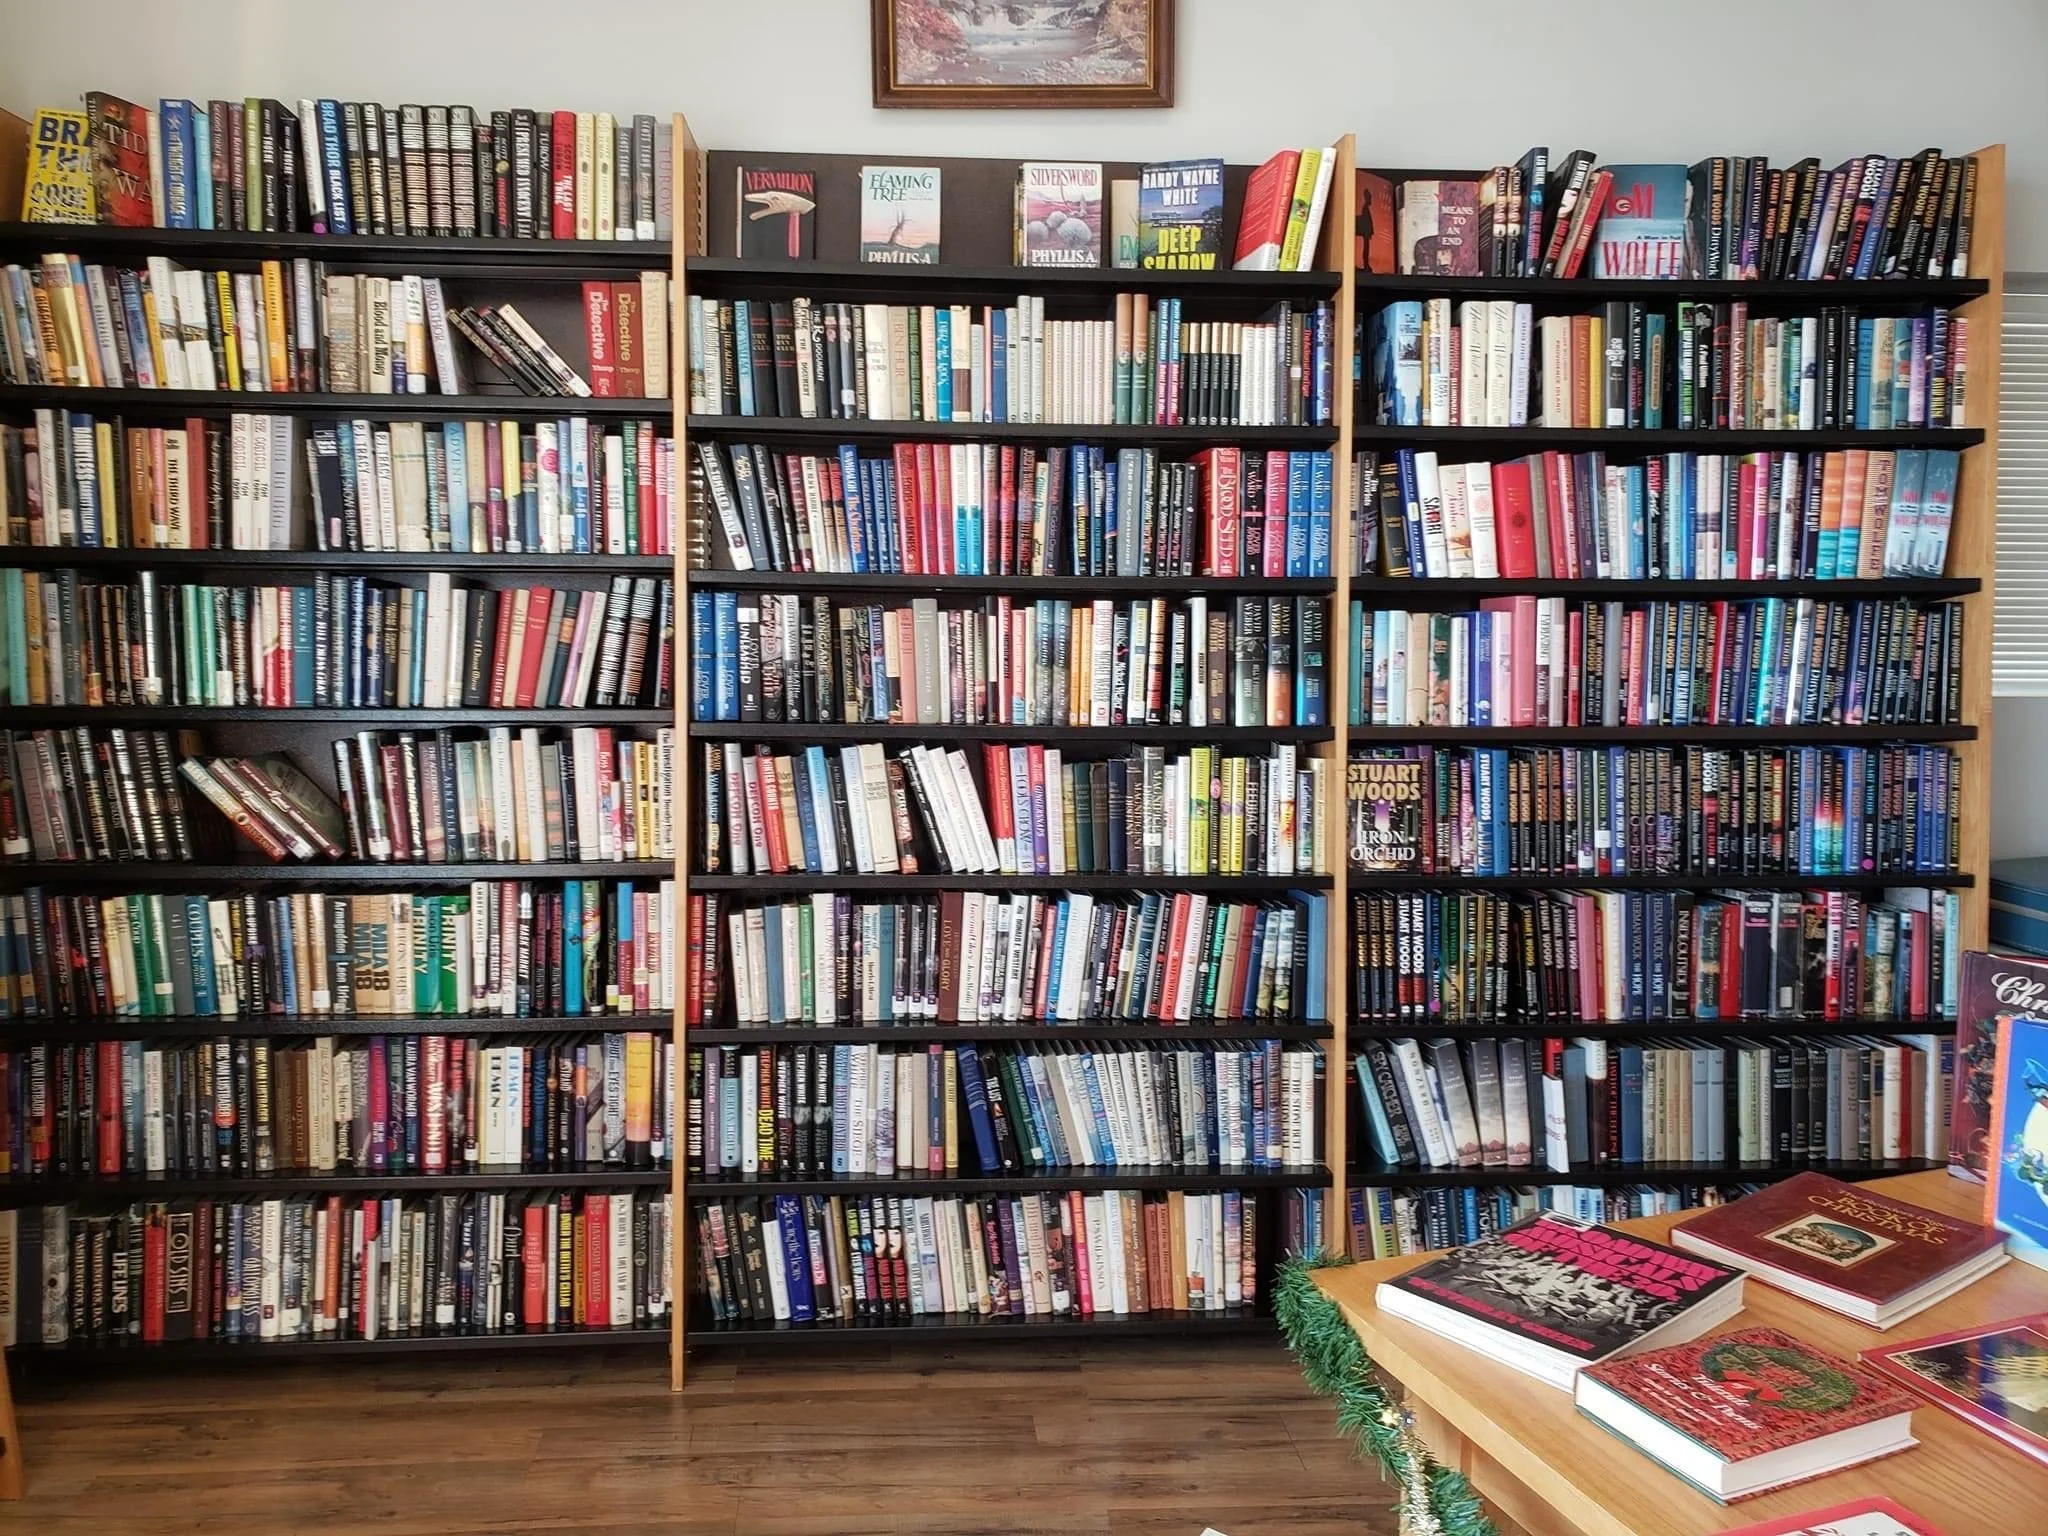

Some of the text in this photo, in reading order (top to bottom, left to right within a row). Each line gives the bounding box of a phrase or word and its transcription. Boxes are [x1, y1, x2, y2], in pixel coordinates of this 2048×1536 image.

[321, 103, 346, 220] BRAD THOR BLACK LIST
[539, 132, 549, 171] TUROW
[659, 147, 672, 217] TUROW
[745, 171, 814, 193] VERMILION
[870, 172, 934, 190] FLAMING
[870, 187, 907, 202] TREE
[1030, 168, 1097, 186] SILVERSWORD
[1143, 169, 1219, 189] RANDY WAYNE
[1162, 188, 1198, 206] WHITE
[1837, 161, 1863, 231] STUART WOODS
[1915, 153, 1935, 215] STUART WOODS
[1441, 206, 1474, 215] MEANS
[1446, 227, 1460, 236] AN
[1453, 217, 1466, 226] TO
[1158, 226, 1202, 254] DEEP
[1442, 237, 1463, 246] END
[1603, 240, 1682, 277] WOLFE
[425, 284, 445, 344] BRAD THOR
[589, 291, 605, 360] Detective
[618, 293, 631, 361] Detective
[372, 302, 387, 376] Blood and Money
[800, 361, 810, 397] DOCUMENT
[73, 427, 94, 480] DAUNTLESS
[843, 451, 857, 493] WAMBAUGH
[168, 459, 179, 530] THE THIRD WAVE
[241, 483, 249, 496] TOM
[260, 483, 269, 498] TOM
[847, 495, 859, 511] The
[1247, 471, 1257, 498] WARD
[1270, 472, 1279, 501] WARD
[1292, 470, 1303, 498] WARD
[1315, 470, 1324, 498] WARD
[905, 516, 916, 553] DARKNESS
[1244, 602, 1253, 635] WEBER
[1252, 605, 1263, 632] DAVID
[1271, 604, 1281, 637] WEBER
[1281, 606, 1290, 634] DAVID
[1303, 611, 1313, 644] WEBER
[1313, 613, 1322, 642] DAVID
[1752, 607, 1763, 669] STUART WOODS
[1813, 604, 1826, 668] STUART WOODS
[740, 623, 751, 685] UNLEASHED
[1951, 641, 1959, 668] WOODS
[662, 744, 672, 797] Investigation
[1347, 783, 1421, 801] WOODS
[1348, 764, 1421, 782] STUART
[1479, 753, 1492, 820] STUART WOODS
[1922, 751, 1932, 812] STUART WOODS
[729, 772, 742, 846] DEFCON One
[748, 782, 764, 848] DEFCON One
[1131, 781, 1142, 851] MAGNIFICENT
[1246, 782, 1258, 837] FEEDBACK
[1350, 848, 1417, 862] ORCHID
[1360, 831, 1405, 845] IRON
[187, 903, 200, 957] COUPLES
[333, 902, 348, 983] Armageddon Leon
[412, 904, 426, 974] TRINITY
[440, 904, 456, 974] TRINITY
[518, 924, 530, 979] MASK MARKET
[1371, 900, 1381, 968] STUART WOODS
[1385, 900, 1395, 967] STUART WOODS
[1399, 899, 1411, 975] STUART WOODS
[1413, 899, 1425, 974] STUART WOODS
[355, 923, 371, 990] MILA 18
[372, 924, 389, 991] MILA 18
[215, 1044, 232, 1117] ERIC VAN LUSTBADER
[255, 1047, 269, 1122] ERIC VAN LUSTBADER
[405, 1041, 418, 1117] LAURA VAN WORMER
[759, 1049, 771, 1081] STEPHEN
[797, 1053, 806, 1104] STEPHEN WHITE
[817, 1053, 827, 1103] STEPHEN WHITE
[760, 1083, 772, 1109] WHITE
[689, 1099, 701, 1156] NIGHT VISION
[758, 1110, 774, 1137] DEAD
[759, 1138, 774, 1161] TIME
[861, 1209, 872, 1235] LIS WIEHL
[873, 1197, 884, 1228] LIS WIEHL
[889, 1198, 900, 1228] LIS WIEHL
[1802, 1193, 1948, 1247] CHRISTMAS
[1834, 1196, 1947, 1236] BOOK OF
[169, 1232, 190, 1294] OLD SINS
[590, 1222, 602, 1302] HANDSOME WOMEN
[1493, 1232, 1552, 1254] OF
[1534, 1247, 1629, 1281] THE
[1513, 1224, 1711, 1291] MUSICALS
[243, 1257, 258, 1317] GALLOWGLASS
[1639, 1362, 1700, 1390] Stories
[1707, 1402, 1768, 1431] Poems
[1684, 1373, 1759, 1408] Yuletide
